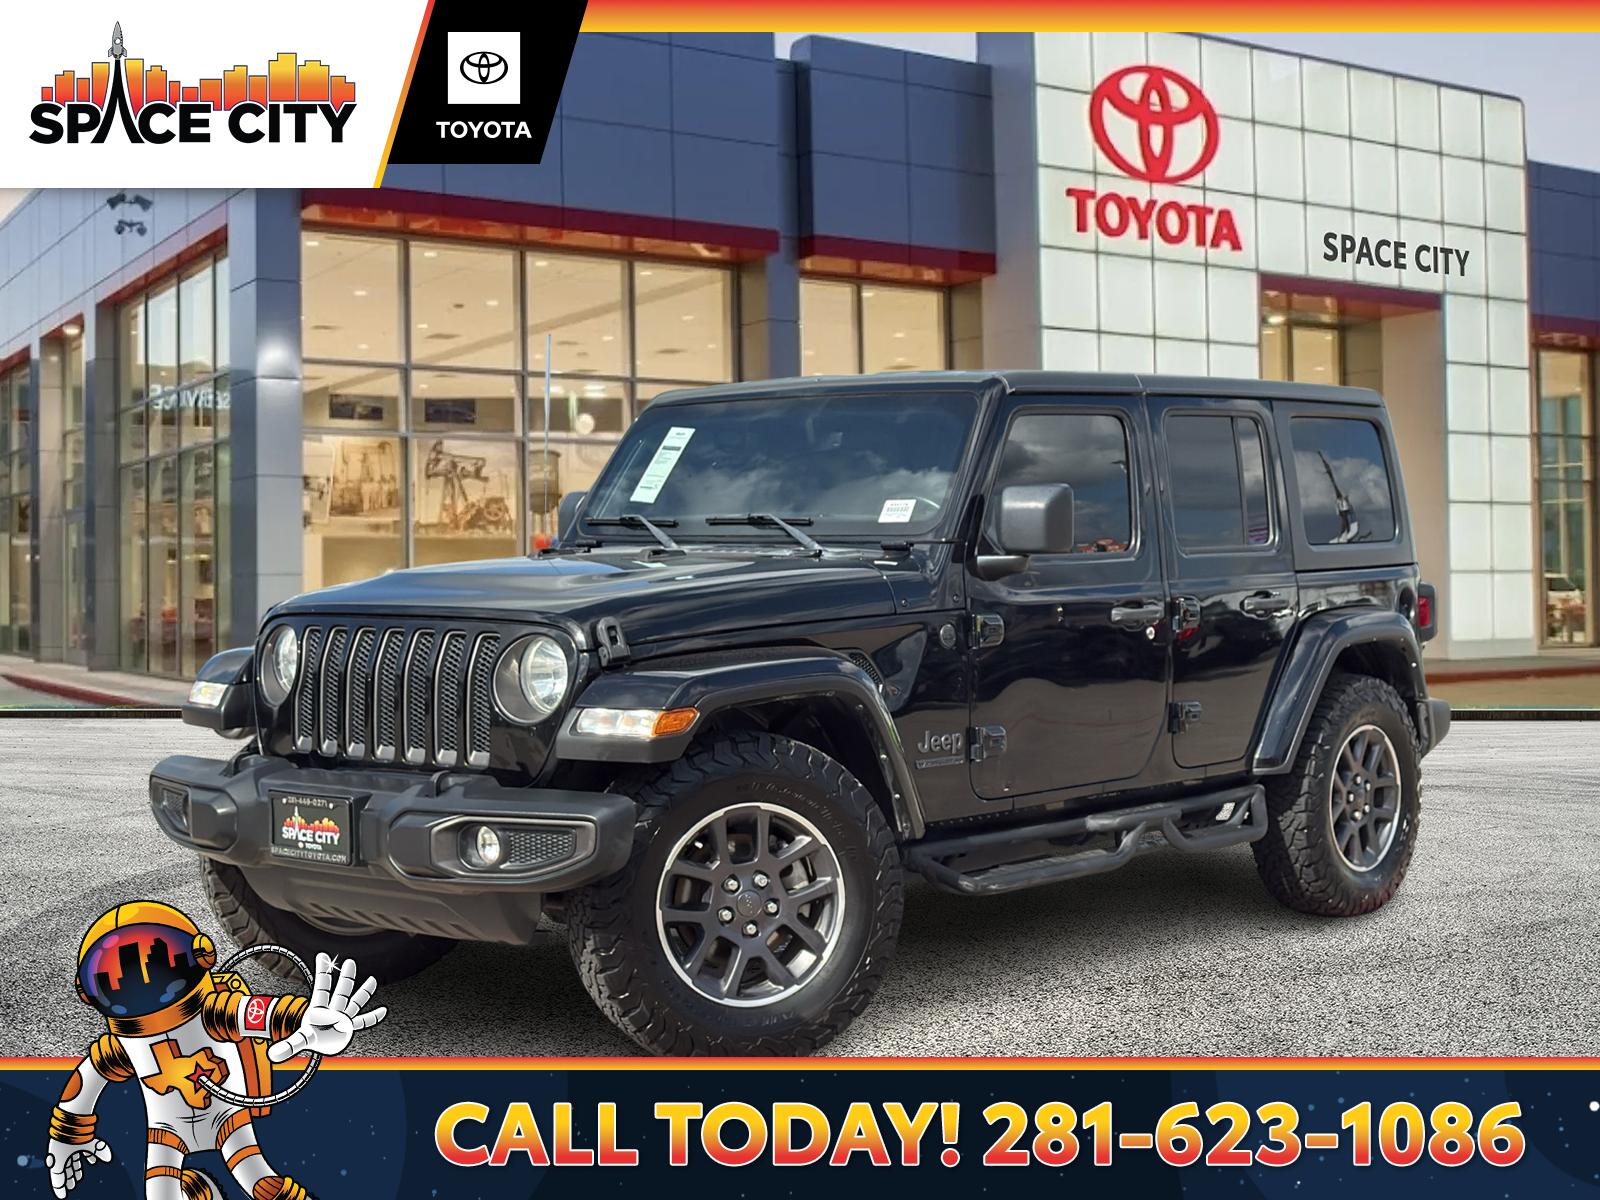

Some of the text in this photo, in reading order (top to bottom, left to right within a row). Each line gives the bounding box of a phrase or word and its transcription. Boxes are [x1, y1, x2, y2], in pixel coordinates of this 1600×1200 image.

[1066, 188, 1242, 251] TOYOTA
[1323, 232, 1469, 276] SPACE CITY
[917, 730, 962, 754] Jeep
[282, 825, 340, 845] SPACE CITY
[305, 842, 322, 850] TOYOTA
